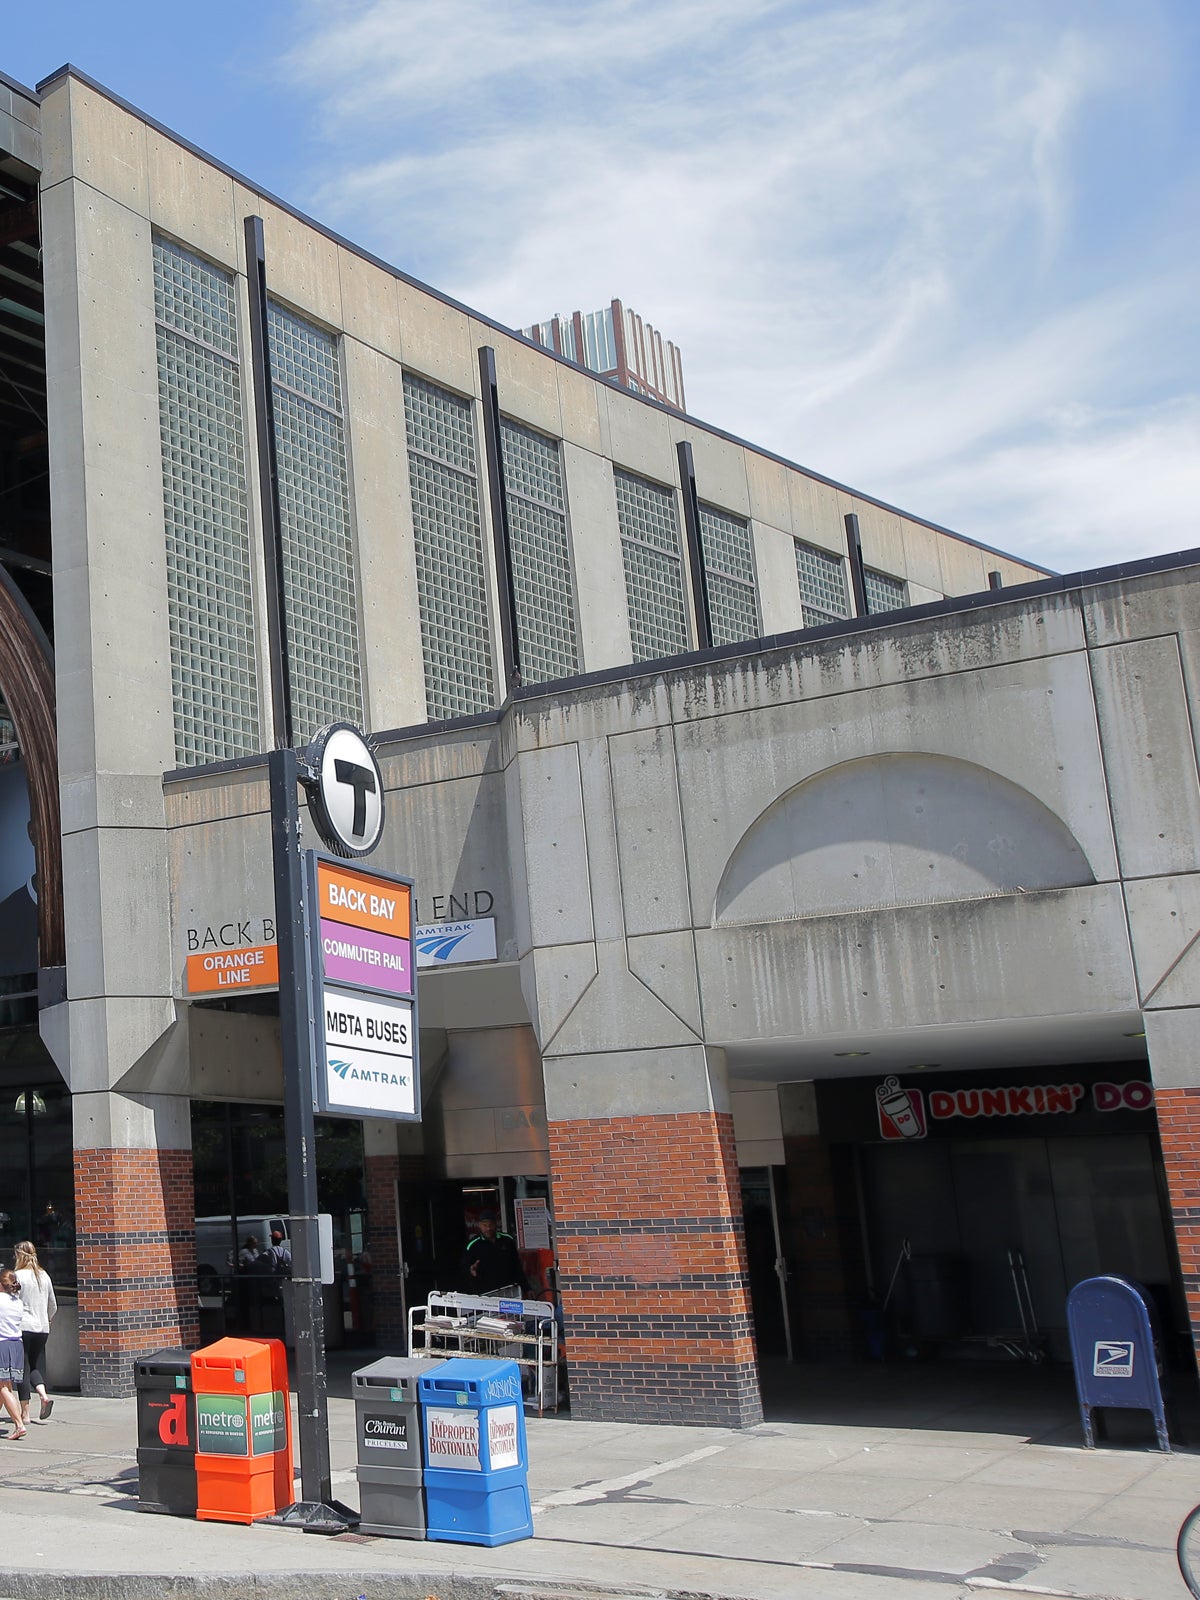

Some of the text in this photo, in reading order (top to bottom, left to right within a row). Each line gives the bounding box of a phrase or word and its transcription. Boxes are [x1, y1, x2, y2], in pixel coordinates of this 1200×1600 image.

[334, 758, 377, 837] T
[328, 883, 368, 914] BACK
[369, 894, 396, 920] BAY
[433, 889, 495, 920] END
[187, 921, 253, 951] BACK
[203, 951, 265, 971] ORANGE
[323, 940, 405, 972] COMMUTER RAIL
[218, 968, 250, 986] LINE
[326, 1010, 408, 1045] MBTA BUSES
[351, 1068, 408, 1087] AMTRAK
[930, 1083, 1083, 1119] DUNKIN'
[158, 1393, 189, 1446] d
[200, 1411, 244, 1428] metro
[254, 1408, 283, 1428] metro
[365, 1420, 406, 1436] Courant
[431, 1421, 476, 1441] IMPROPER
[367, 1438, 407, 1449] PRICELESS
[429, 1437, 478, 1457] BOSTONIAN
